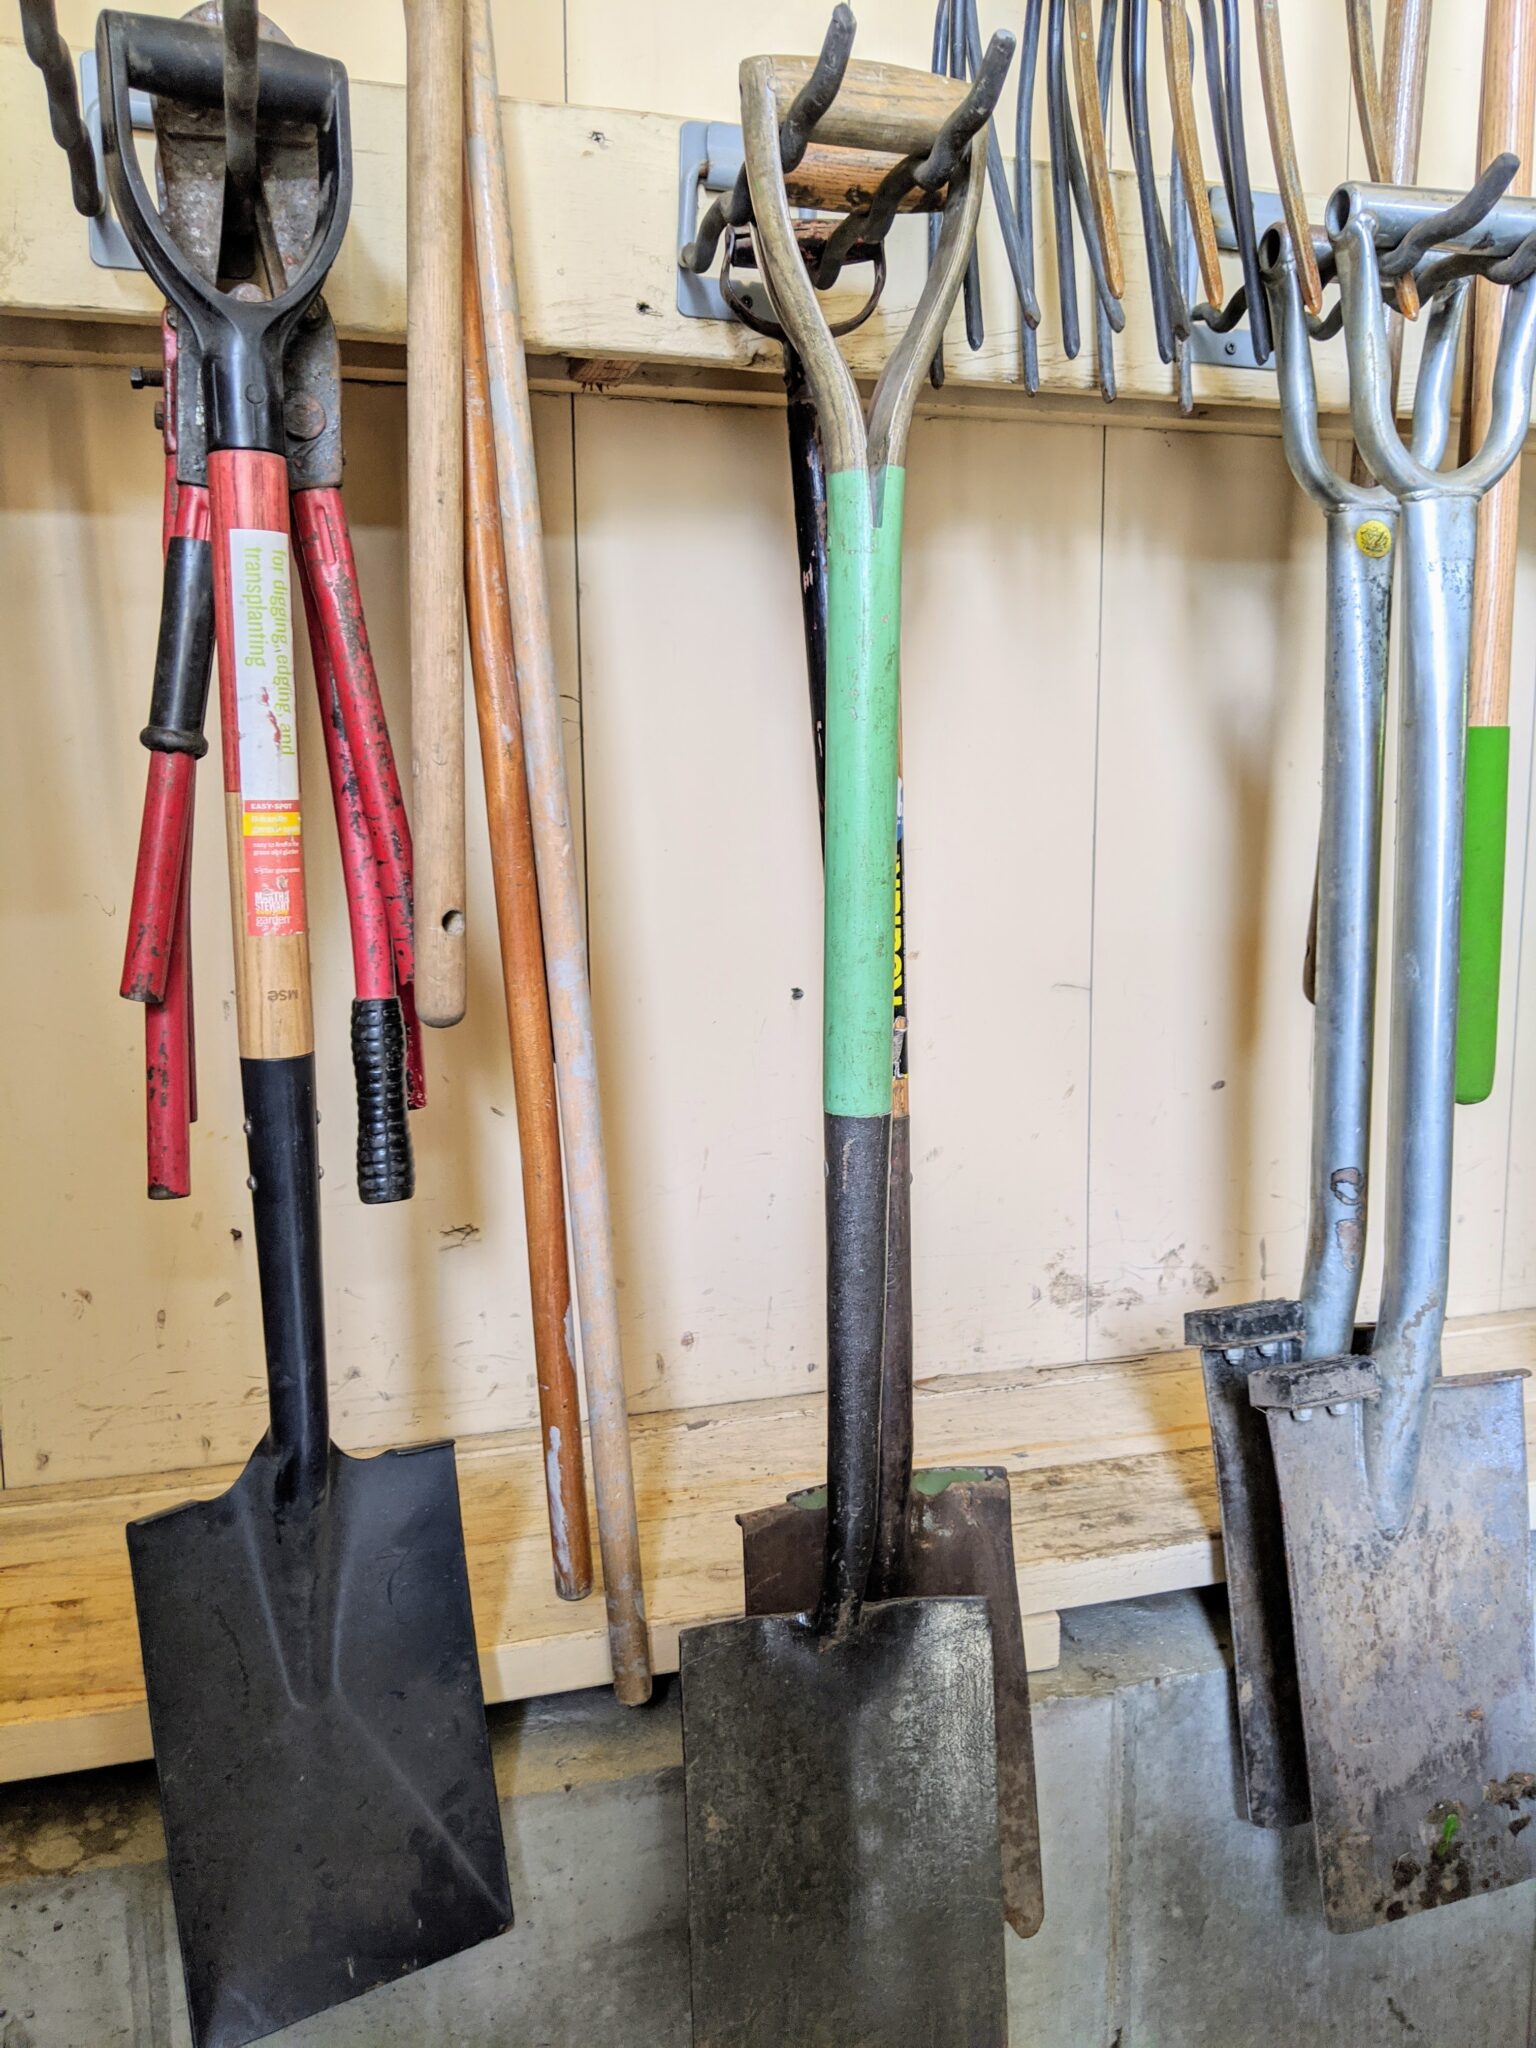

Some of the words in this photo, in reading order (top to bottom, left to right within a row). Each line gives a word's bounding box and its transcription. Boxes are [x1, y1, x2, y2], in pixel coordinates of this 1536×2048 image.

[242, 547, 267, 667] transplanting
[271, 549, 287, 574] for
[280, 723, 295, 755] and
